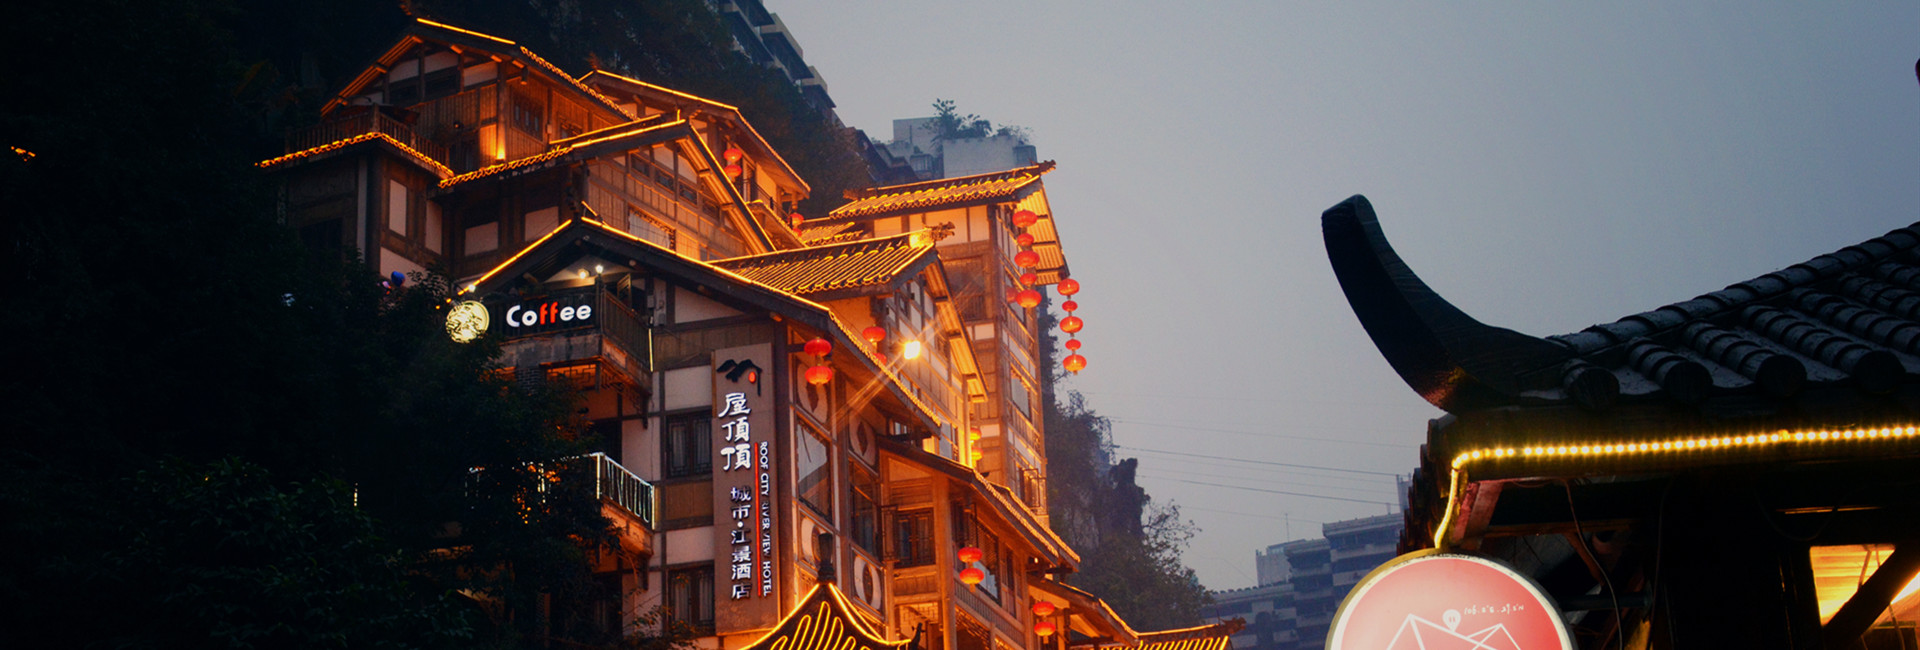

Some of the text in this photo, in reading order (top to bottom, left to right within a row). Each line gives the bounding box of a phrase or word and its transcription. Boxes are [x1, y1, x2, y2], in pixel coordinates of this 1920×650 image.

[506, 301, 592, 328] Coffee
[718, 392, 752, 471] 屋頂頂
[760, 441, 769, 470] ROOF
[760, 473, 770, 497] CITY
[763, 561, 772, 597] HOTEL
